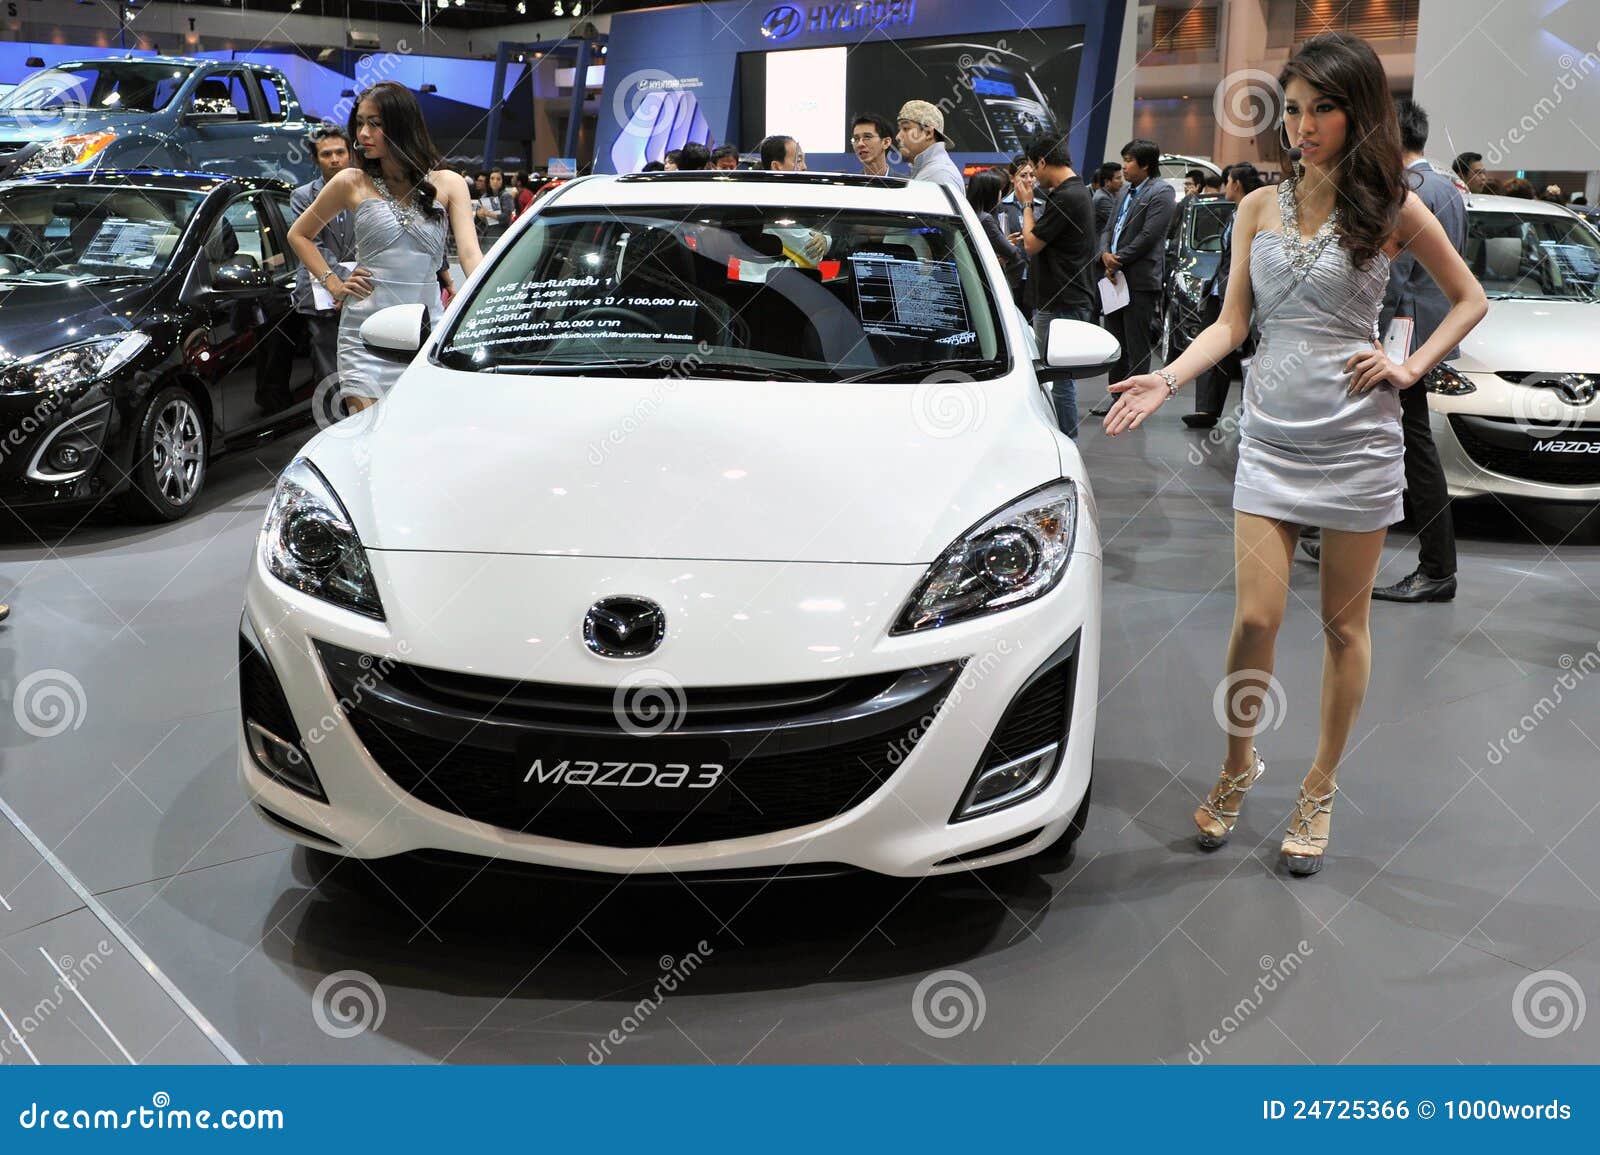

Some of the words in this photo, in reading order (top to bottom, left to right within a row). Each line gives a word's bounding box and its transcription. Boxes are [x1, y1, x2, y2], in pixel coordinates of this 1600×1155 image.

[807, 0, 915, 31] HYUNDAI
[628, 298, 675, 307] 100,000
[553, 320, 594, 329] 20,000
